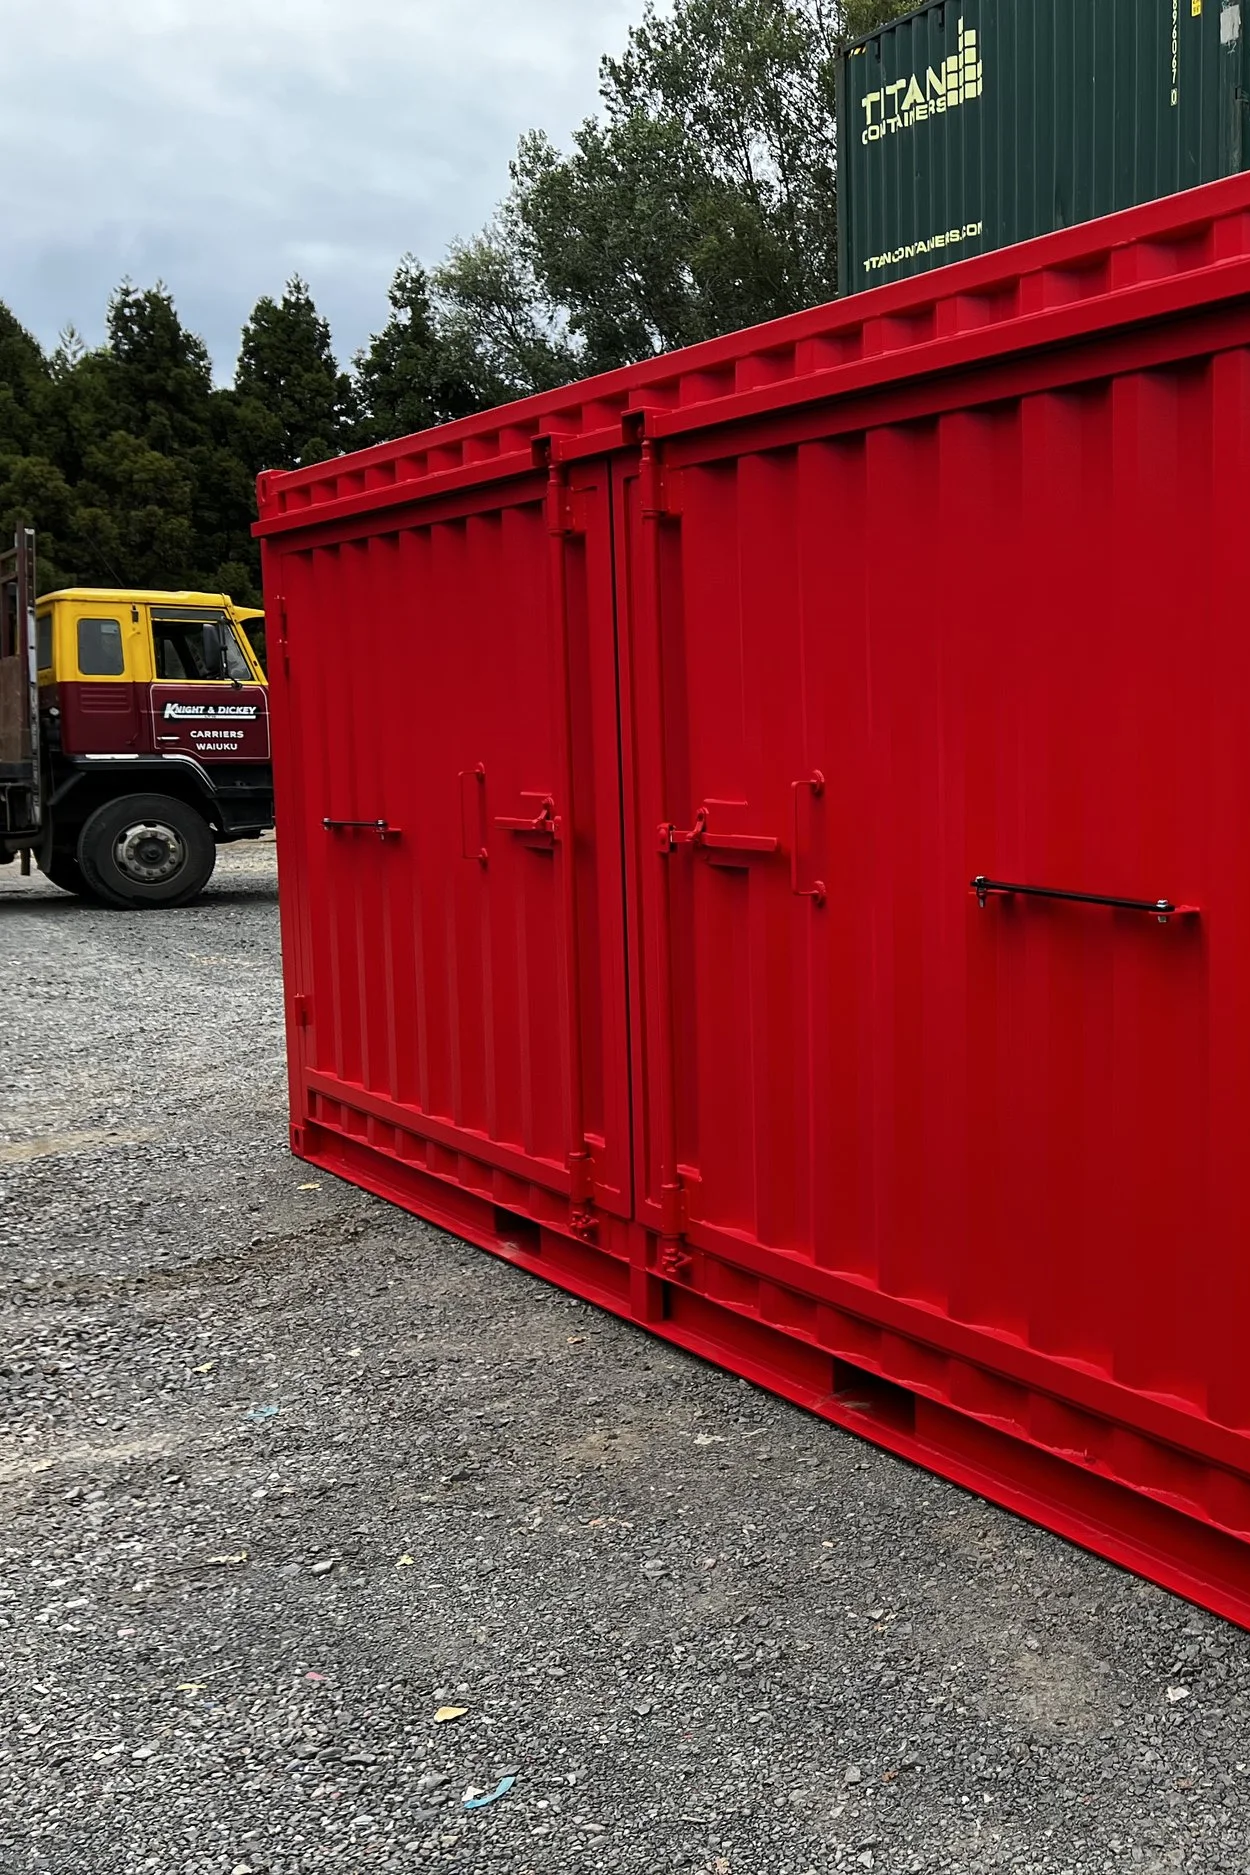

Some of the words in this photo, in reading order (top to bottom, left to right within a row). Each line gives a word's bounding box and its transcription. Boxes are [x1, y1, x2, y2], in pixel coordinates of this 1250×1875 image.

[861, 61, 947, 125] TITAN
[861, 95, 947, 145] CONTAINERS
[207, 706, 215, 714] &
[217, 706, 257, 715] DICKEY
[190, 730, 244, 738] CARRIERS
